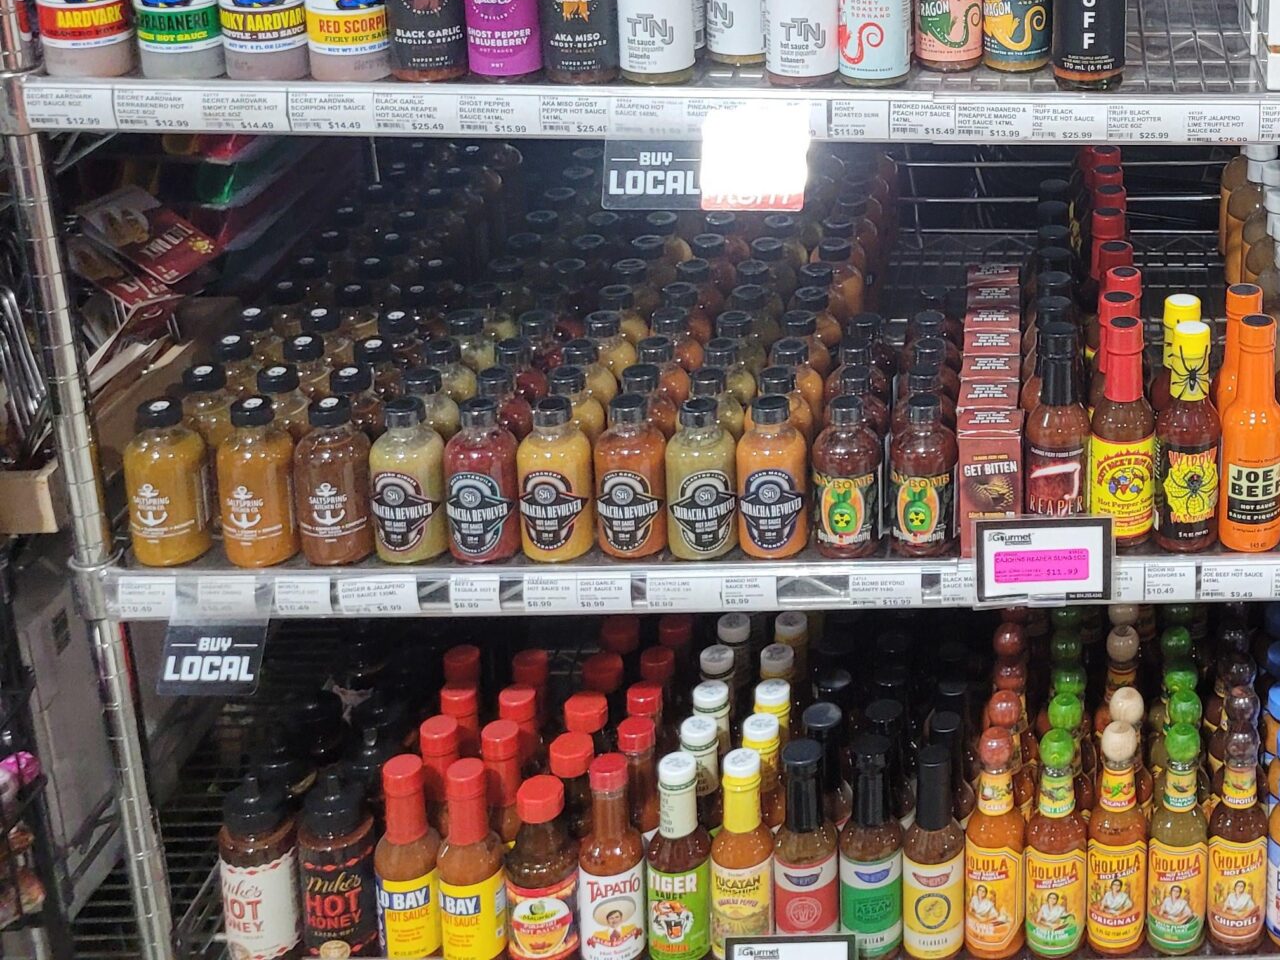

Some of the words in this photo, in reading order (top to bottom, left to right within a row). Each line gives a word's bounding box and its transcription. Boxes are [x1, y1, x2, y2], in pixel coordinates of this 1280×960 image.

[57, 10, 122, 28] AARDVARK
[319, 19, 341, 33] RED
[396, 29, 424, 38] BLACK
[428, 26, 461, 37] GARLIC
[494, 28, 531, 38] PEPPER
[555, 33, 573, 41] AKA
[576, 32, 601, 42] MISO
[241, 121, 274, 129] $14.49
[412, 122, 444, 130] $25.49
[495, 124, 526, 132] $15.99
[834, 128, 864, 136] $11.99
[990, 129, 1019, 138] $13.99
[1139, 131, 1169, 139] $25.99
[639, 152, 673, 166] BUY
[609, 170, 700, 195] LOCAL
[964, 463, 982, 477] GET
[984, 461, 1018, 476] BITTEN
[1232, 468, 1273, 483] JOE
[1029, 496, 1083, 515] REAPER
[198, 637, 233, 652] BUY
[164, 656, 254, 682] LOCAL
[1089, 853, 1142, 874] CHOLULA
[1213, 850, 1265, 870] CHOLULA
[587, 872, 641, 904] TAPATÍO
[651, 875, 698, 892] TIGER
[306, 889, 361, 919] HOT
[394, 886, 429, 909] BAY
[307, 911, 361, 930] HONEY
[406, 906, 431, 921] SAUCE
[1089, 911, 1138, 926] ORIGINAL
[1214, 915, 1257, 928] CHIPOTLE
